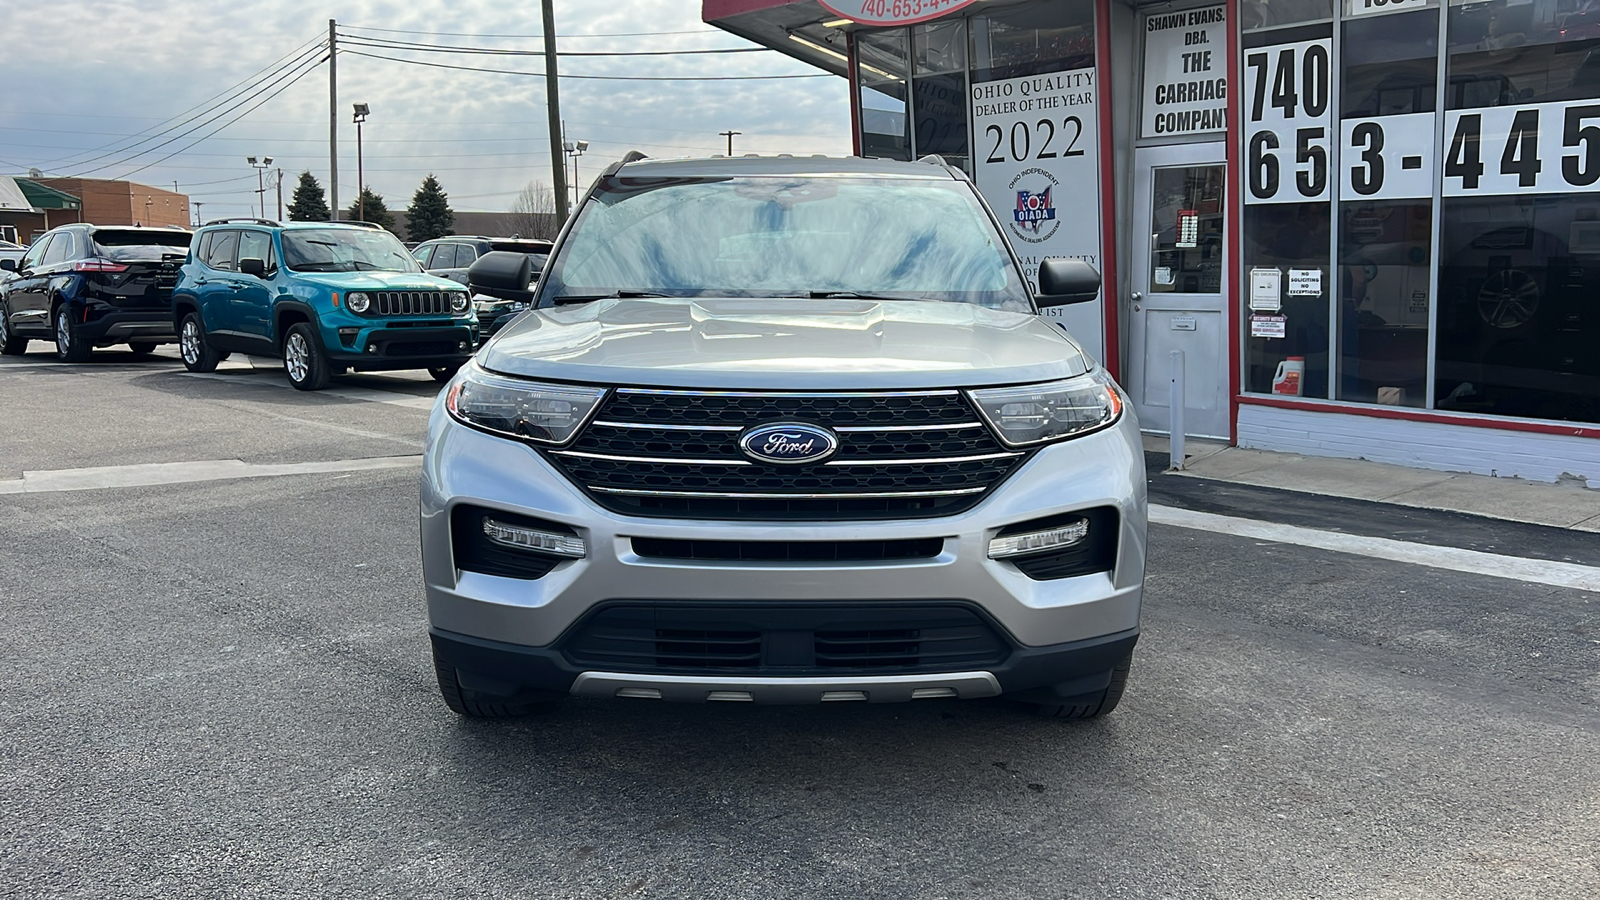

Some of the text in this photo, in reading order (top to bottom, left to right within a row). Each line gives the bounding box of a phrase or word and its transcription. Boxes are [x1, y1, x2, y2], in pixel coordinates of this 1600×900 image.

[1148, 8, 1225, 32] SHAWN EVANS.
[1185, 30, 1209, 46] DBA.
[1182, 51, 1211, 73] THE
[973, 83, 1013, 100] OHIO
[1020, 72, 1094, 96] QUALITY
[1247, 44, 1329, 122] 740
[975, 102, 1017, 117] DEALER
[1019, 99, 1034, 112] OF
[1036, 96, 1059, 110] THE
[1061, 92, 1093, 107] YEAR
[985, 115, 1085, 164] 2022
[1008, 167, 1060, 190] OHIO INDEPENDENT
[1018, 209, 1049, 221] OIADA
[1009, 222, 1028, 243] AUTOMOBILE
[1042, 220, 1061, 242] ASSOCIATION
[1025, 268, 1038, 277] OF
[763, 432, 815, 454] Ford
